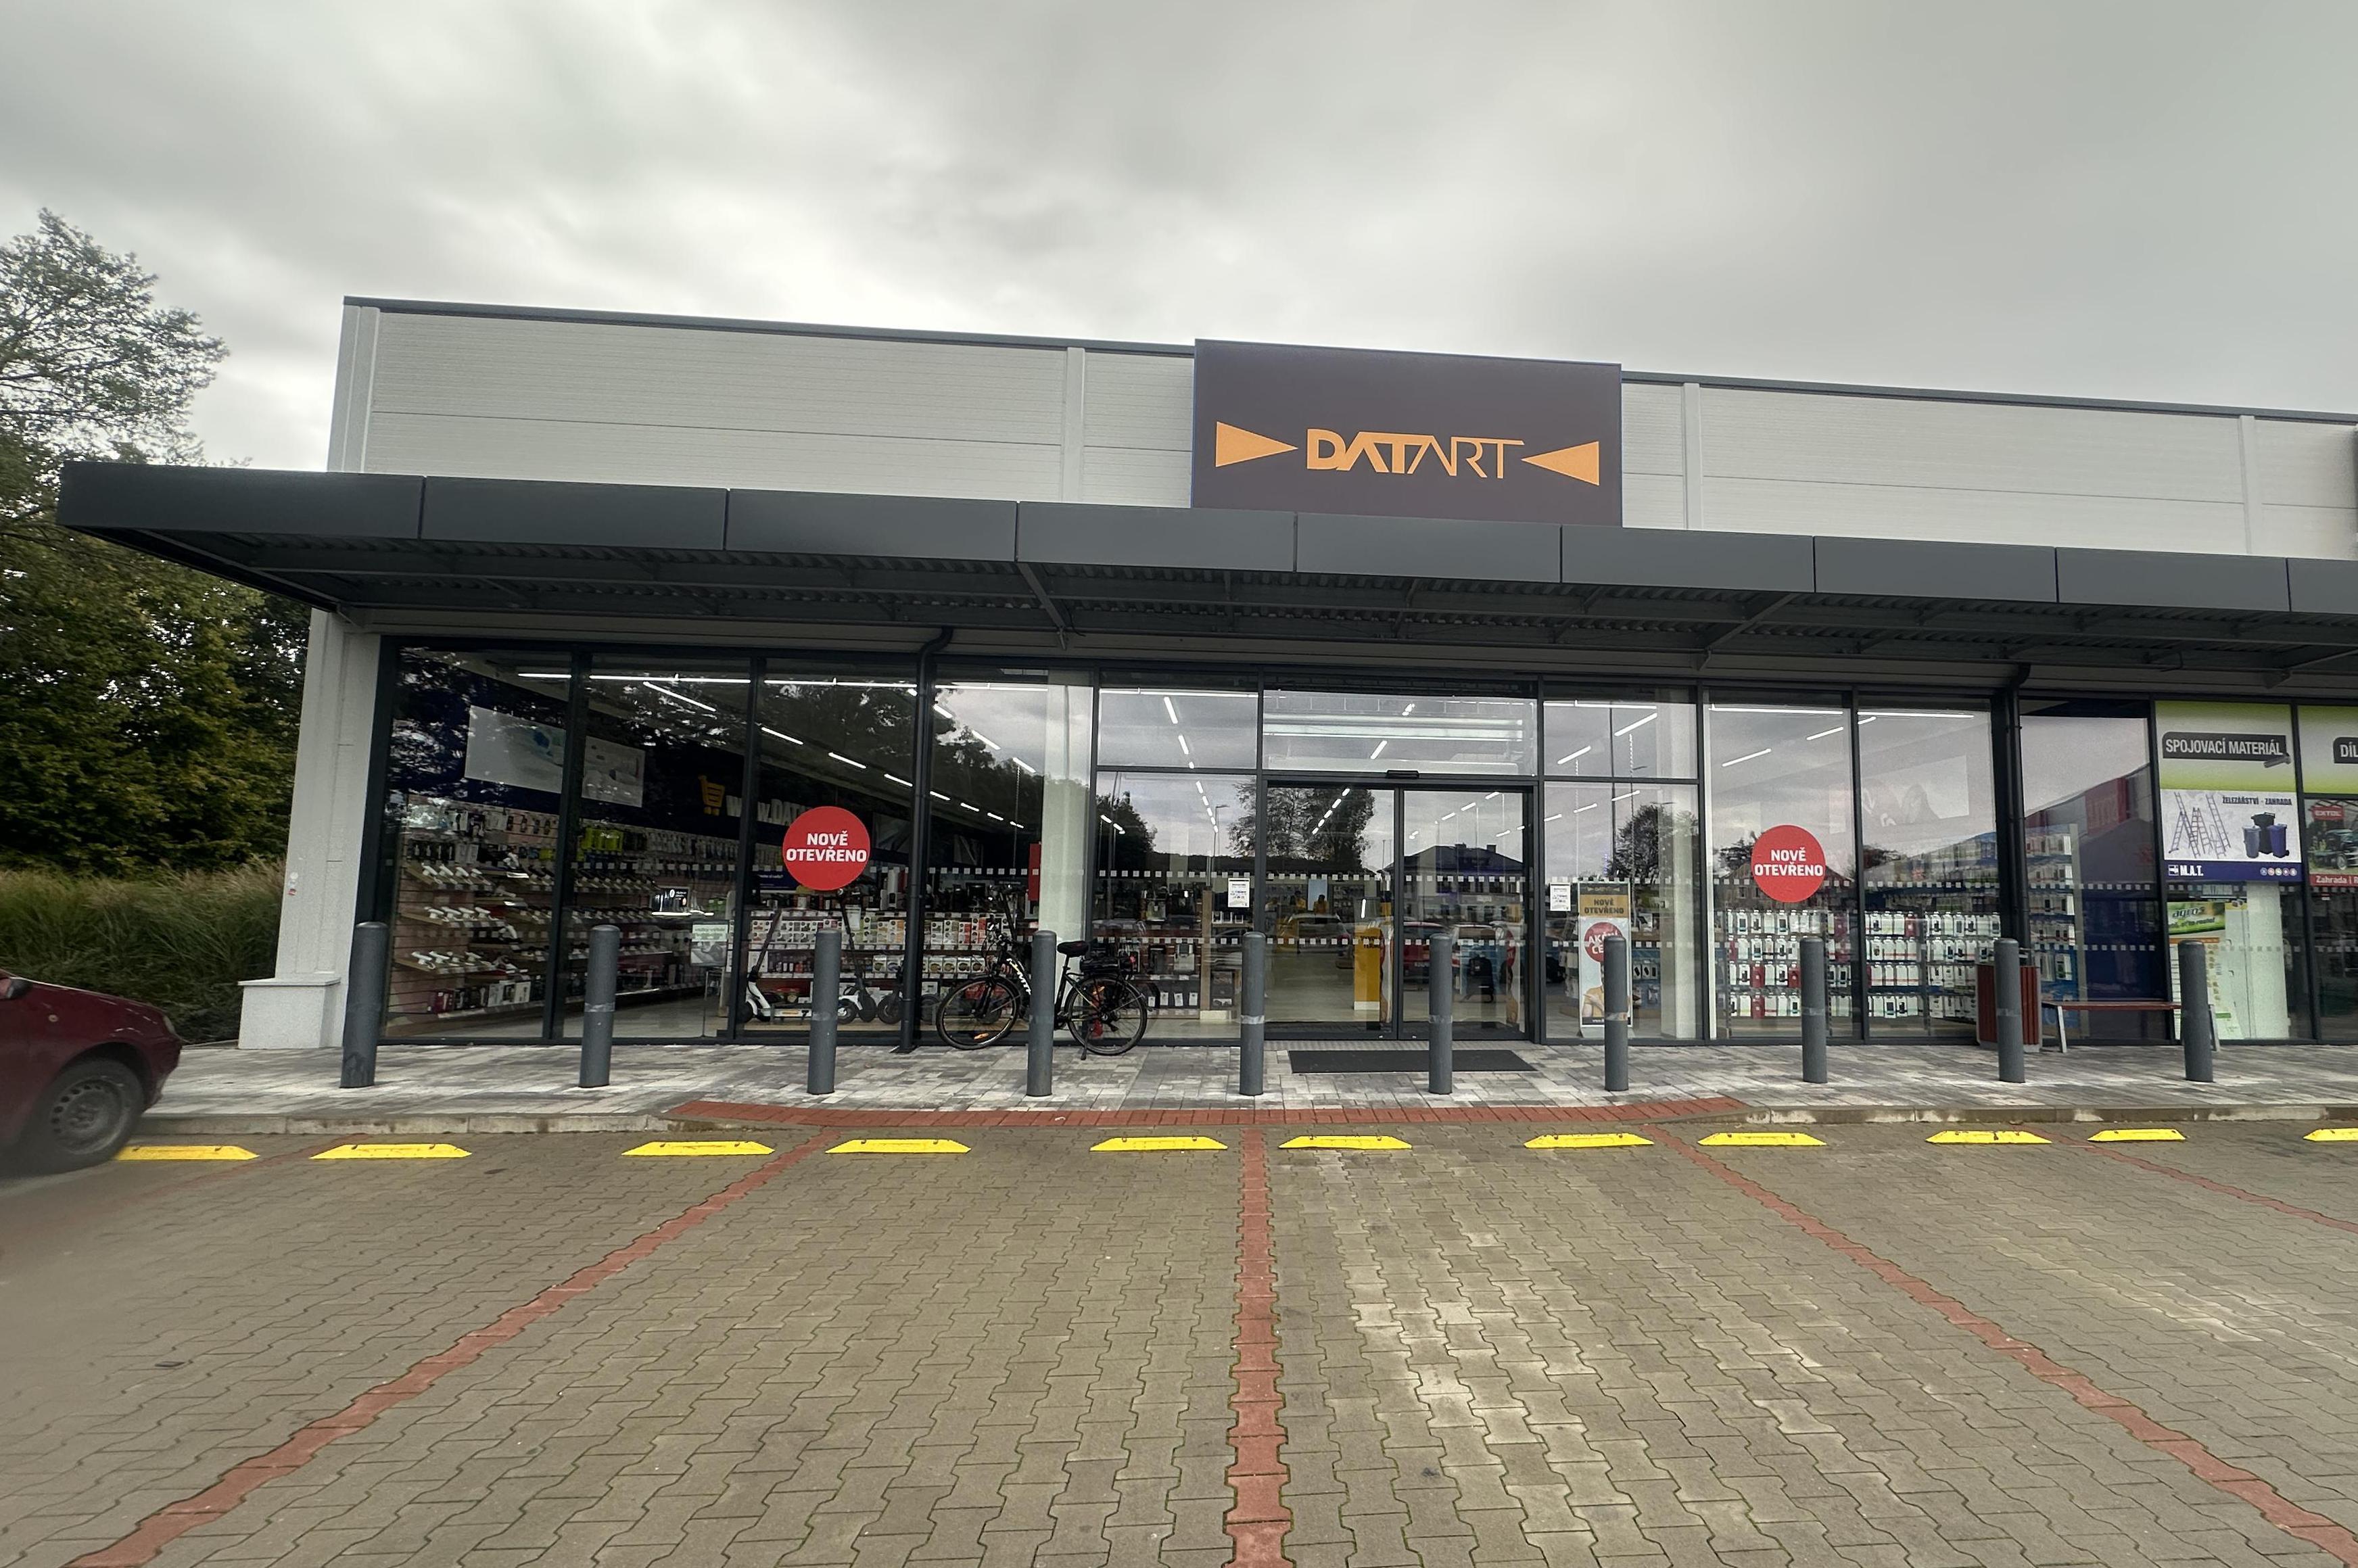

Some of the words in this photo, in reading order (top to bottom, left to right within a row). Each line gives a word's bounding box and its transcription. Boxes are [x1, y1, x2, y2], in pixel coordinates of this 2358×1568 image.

[1307, 429, 1524, 479] DATART
[2166, 738, 2225, 754] SPOJOVACÍ
[2229, 739, 2283, 755] MATERIÁL
[2222, 795, 2259, 805] ŽELEZÁŘSTVÍ
[807, 830, 848, 846] NOVĚ
[786, 846, 868, 862] OTEVŘENO
[1771, 847, 1806, 861] NOVĚ
[1754, 861, 1823, 876] OTEVŘENO
[2315, 876, 2347, 884] Zahrada
